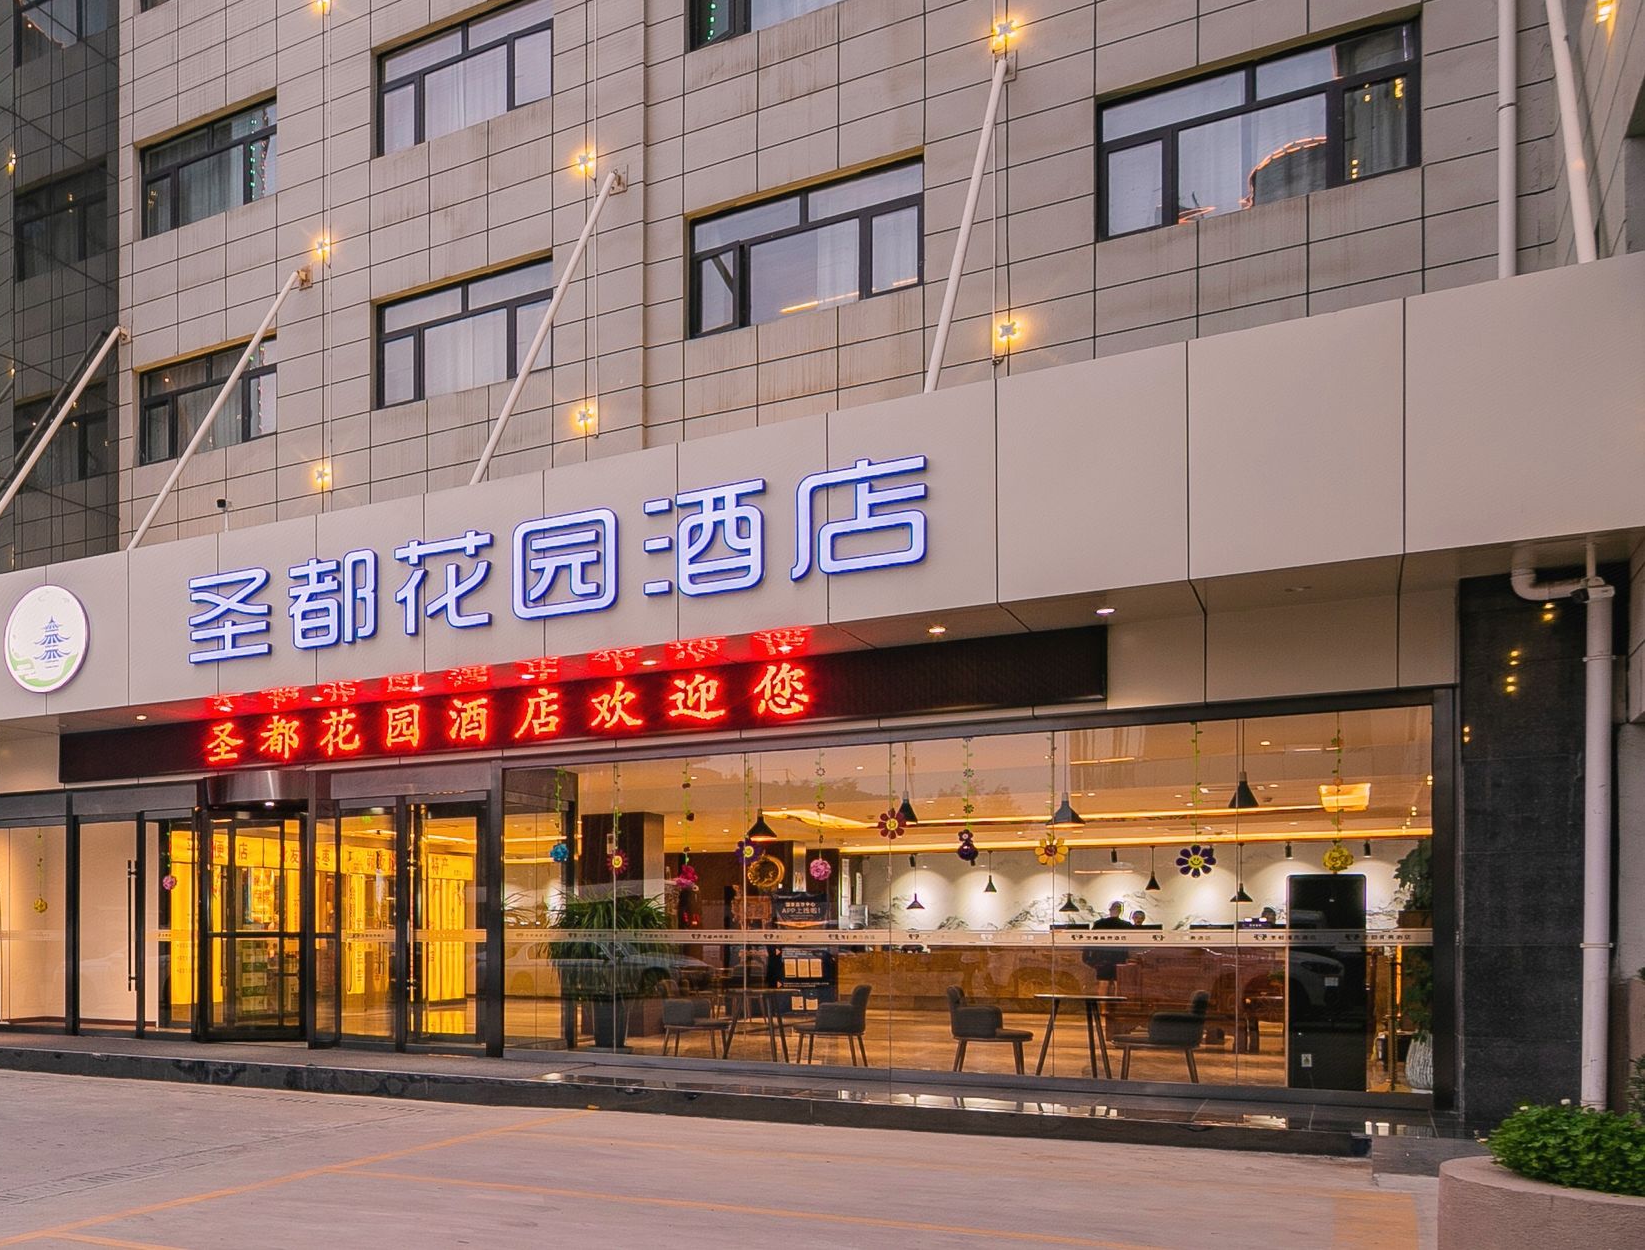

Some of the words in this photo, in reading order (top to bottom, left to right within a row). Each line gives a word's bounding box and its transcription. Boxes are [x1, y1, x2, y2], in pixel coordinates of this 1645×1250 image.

[188, 455, 928, 666] 圣都花园酒店
[207, 664, 811, 763] 圣都花园酒店欢迎您
